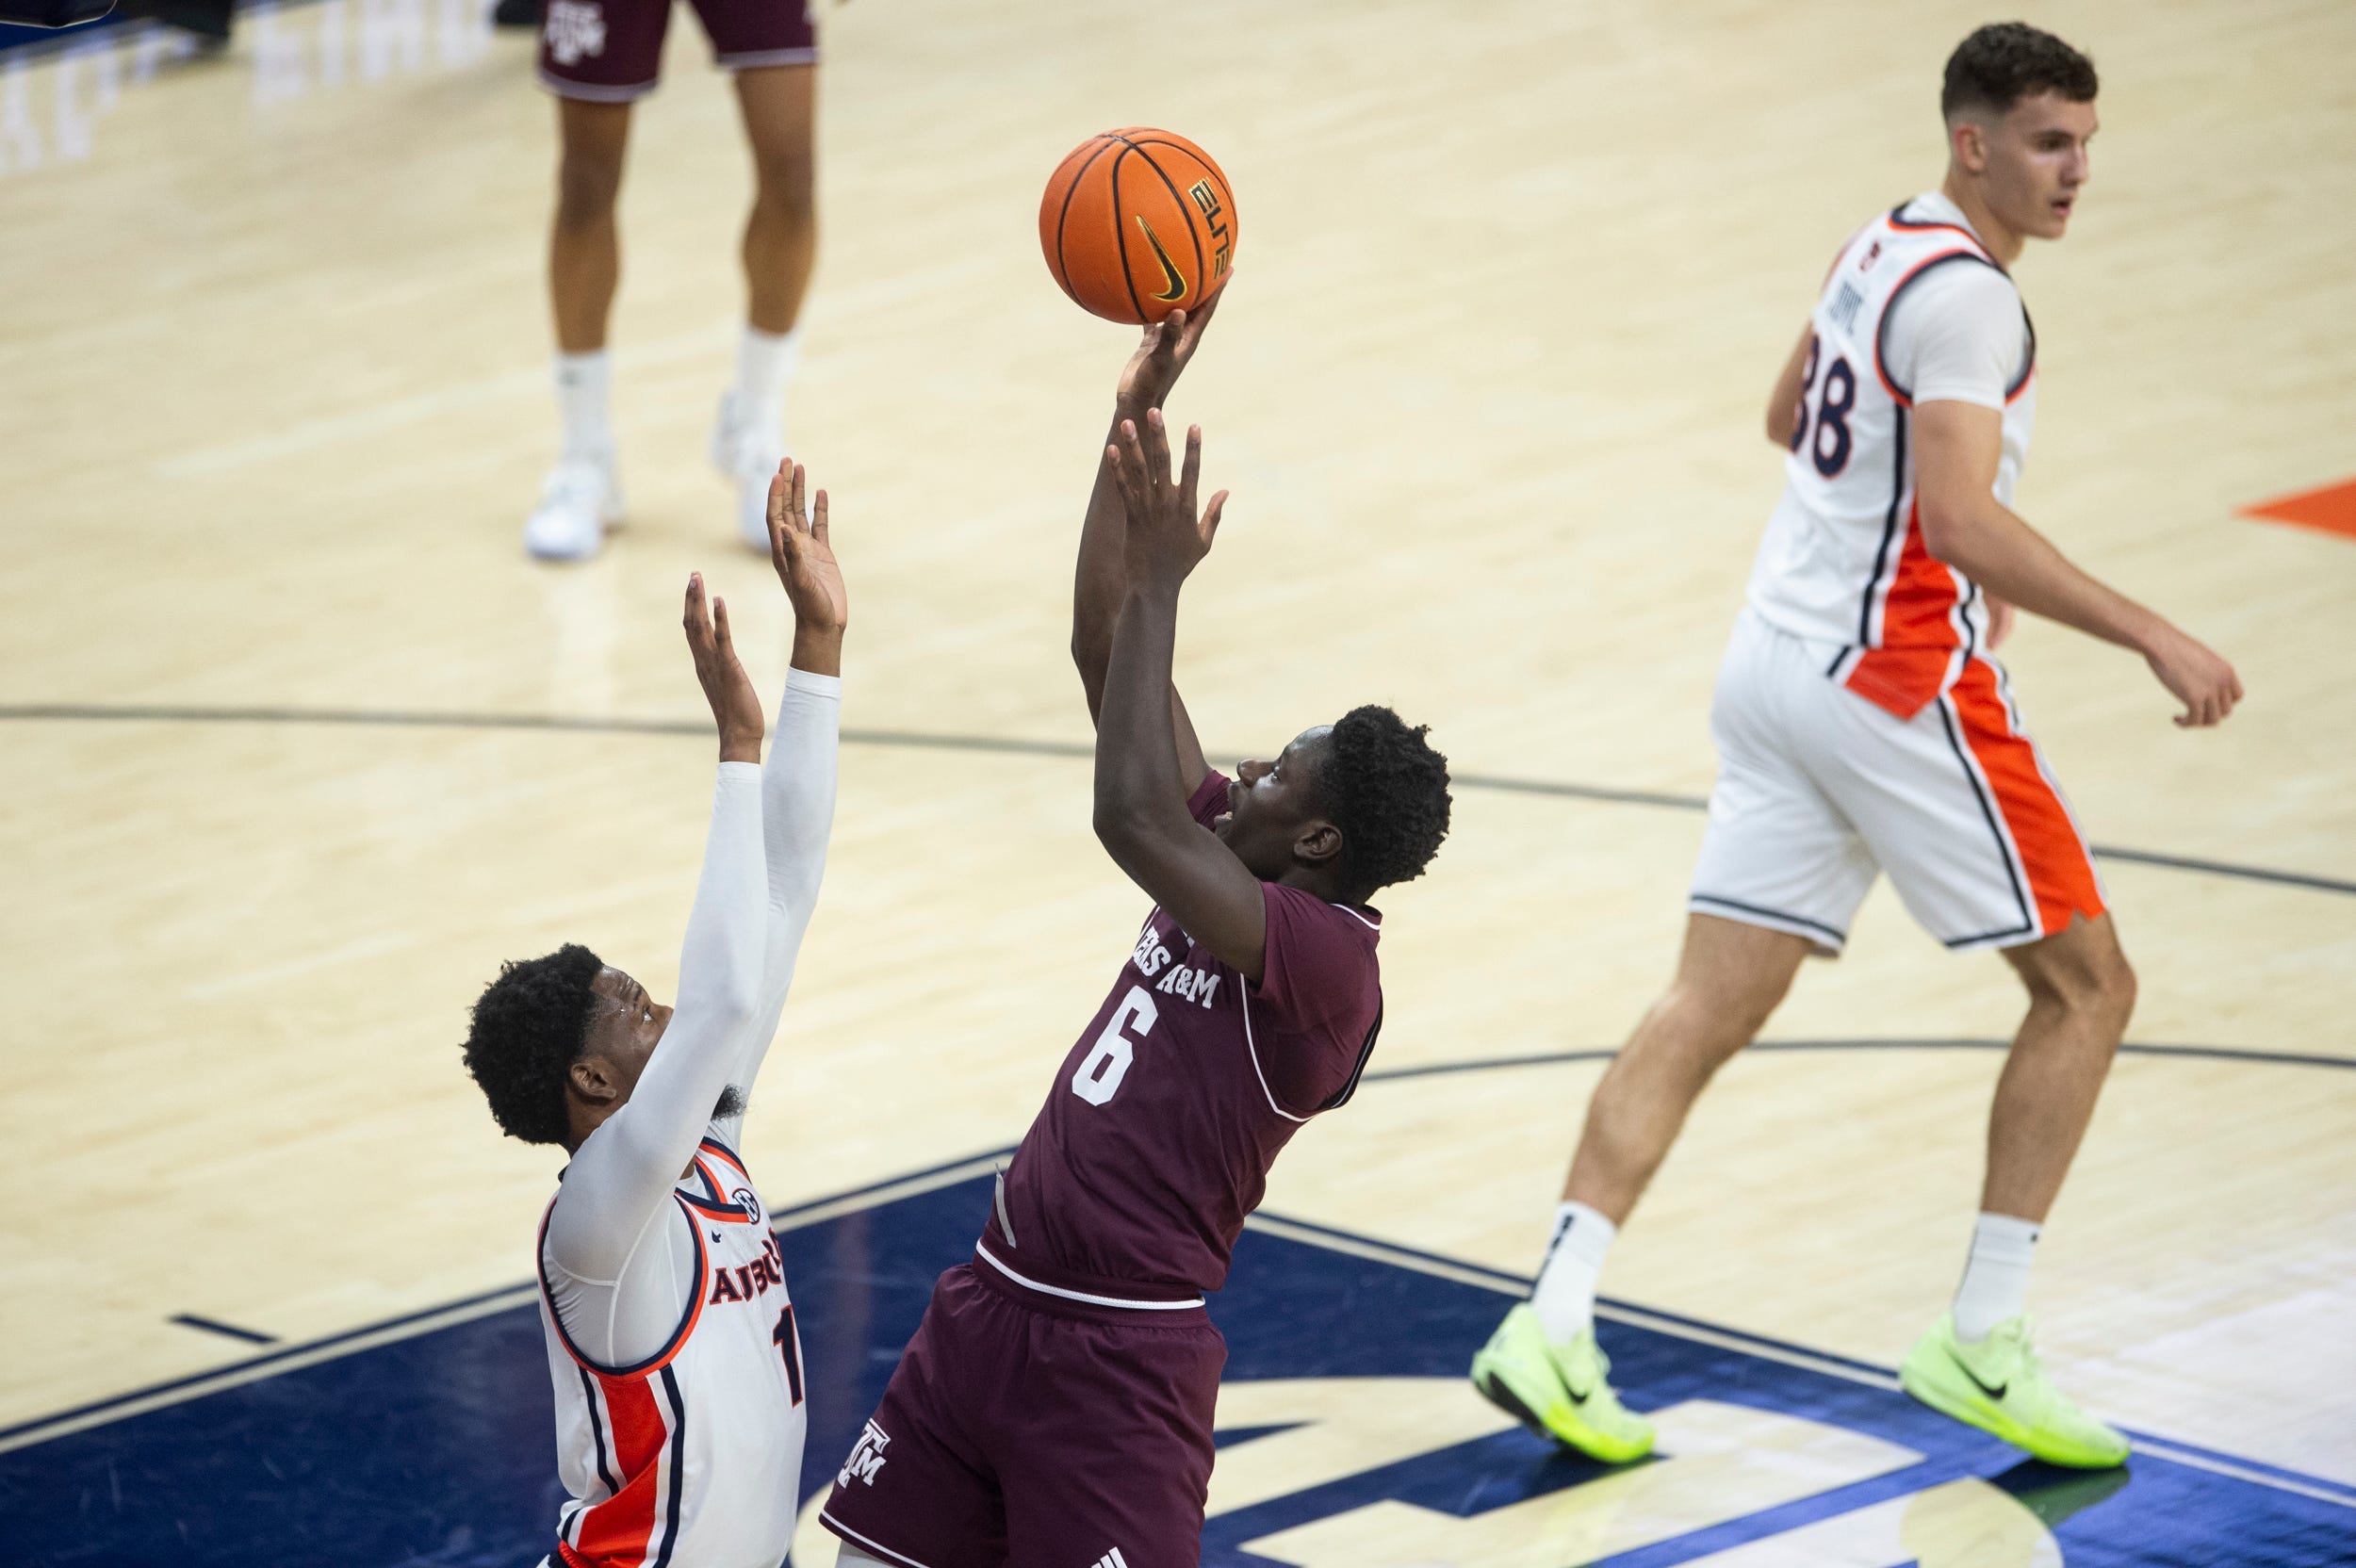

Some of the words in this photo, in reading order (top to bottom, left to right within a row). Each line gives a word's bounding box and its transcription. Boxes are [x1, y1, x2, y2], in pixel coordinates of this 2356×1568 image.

[1188, 176, 1231, 280] ELITE
[1155, 964, 1220, 1009] A&M
[1072, 985, 1159, 1107] 6
[773, 1304, 803, 1409] 1
